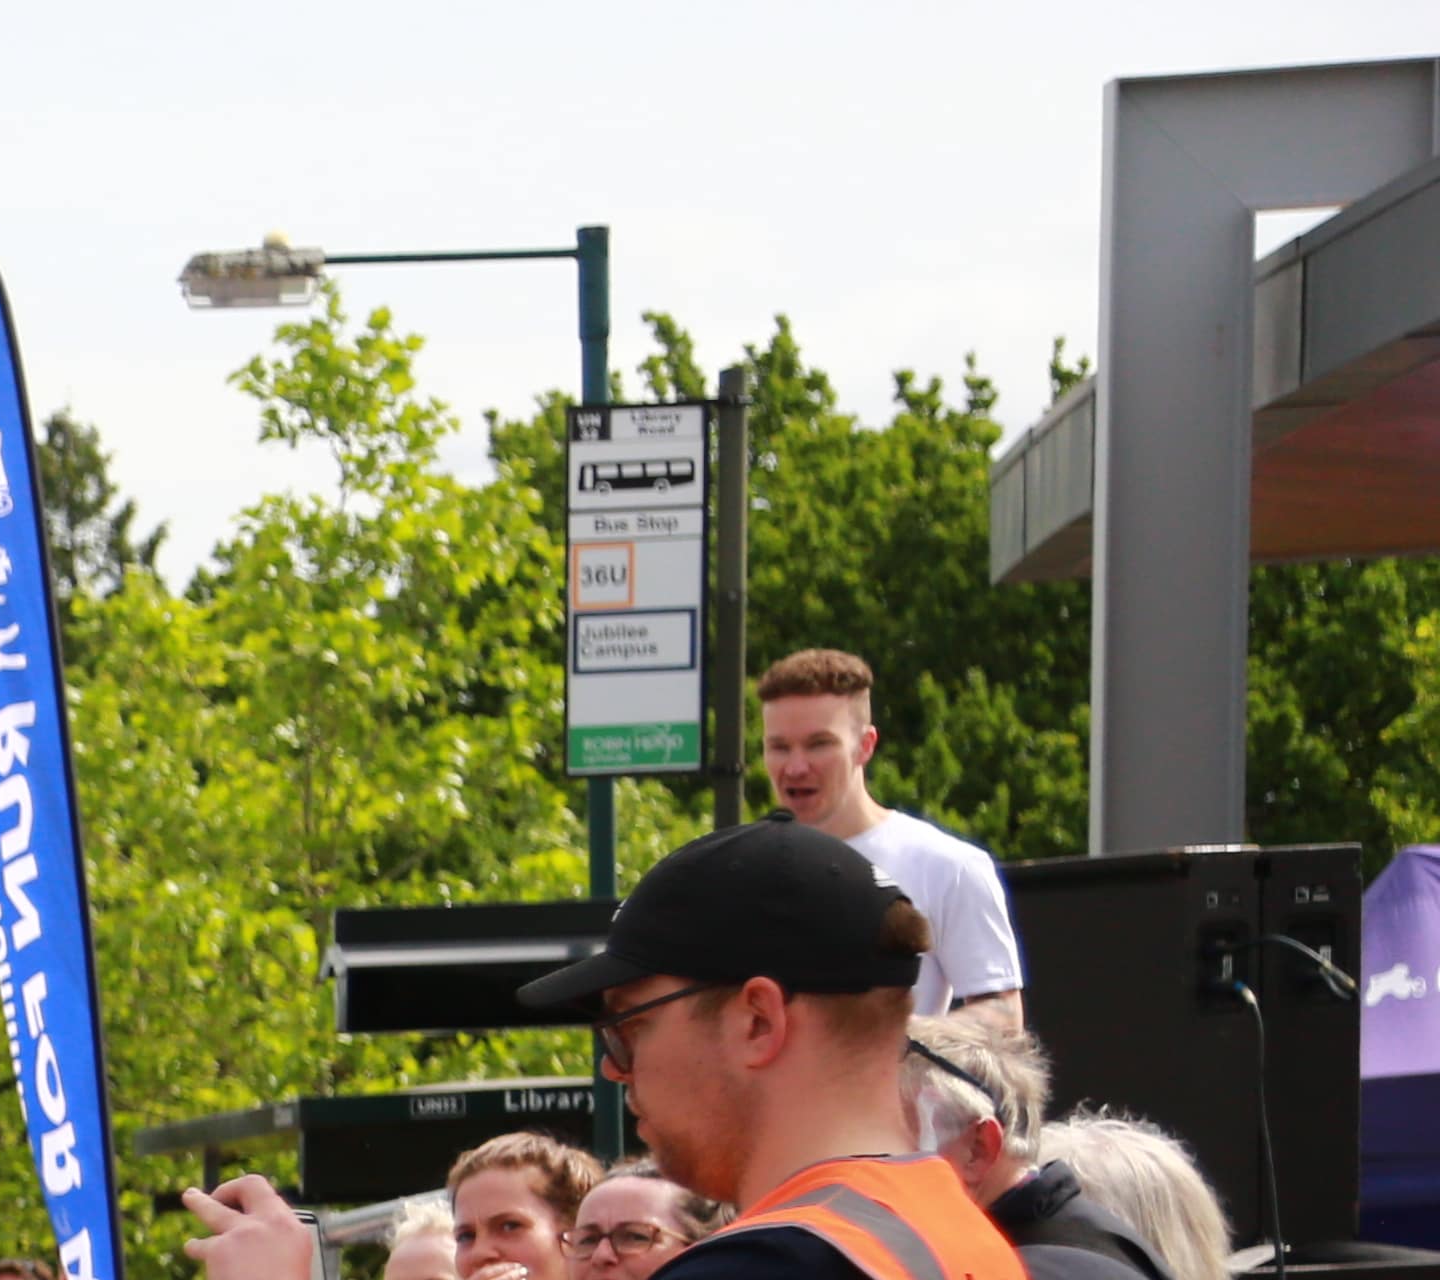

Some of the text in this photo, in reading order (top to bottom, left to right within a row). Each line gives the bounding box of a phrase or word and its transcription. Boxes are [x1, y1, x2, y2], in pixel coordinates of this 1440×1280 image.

[594, 514, 678, 535] Bus Stop
[581, 564, 627, 587] 36U
[583, 623, 648, 642] Jubilee
[581, 643, 658, 659] Campus
